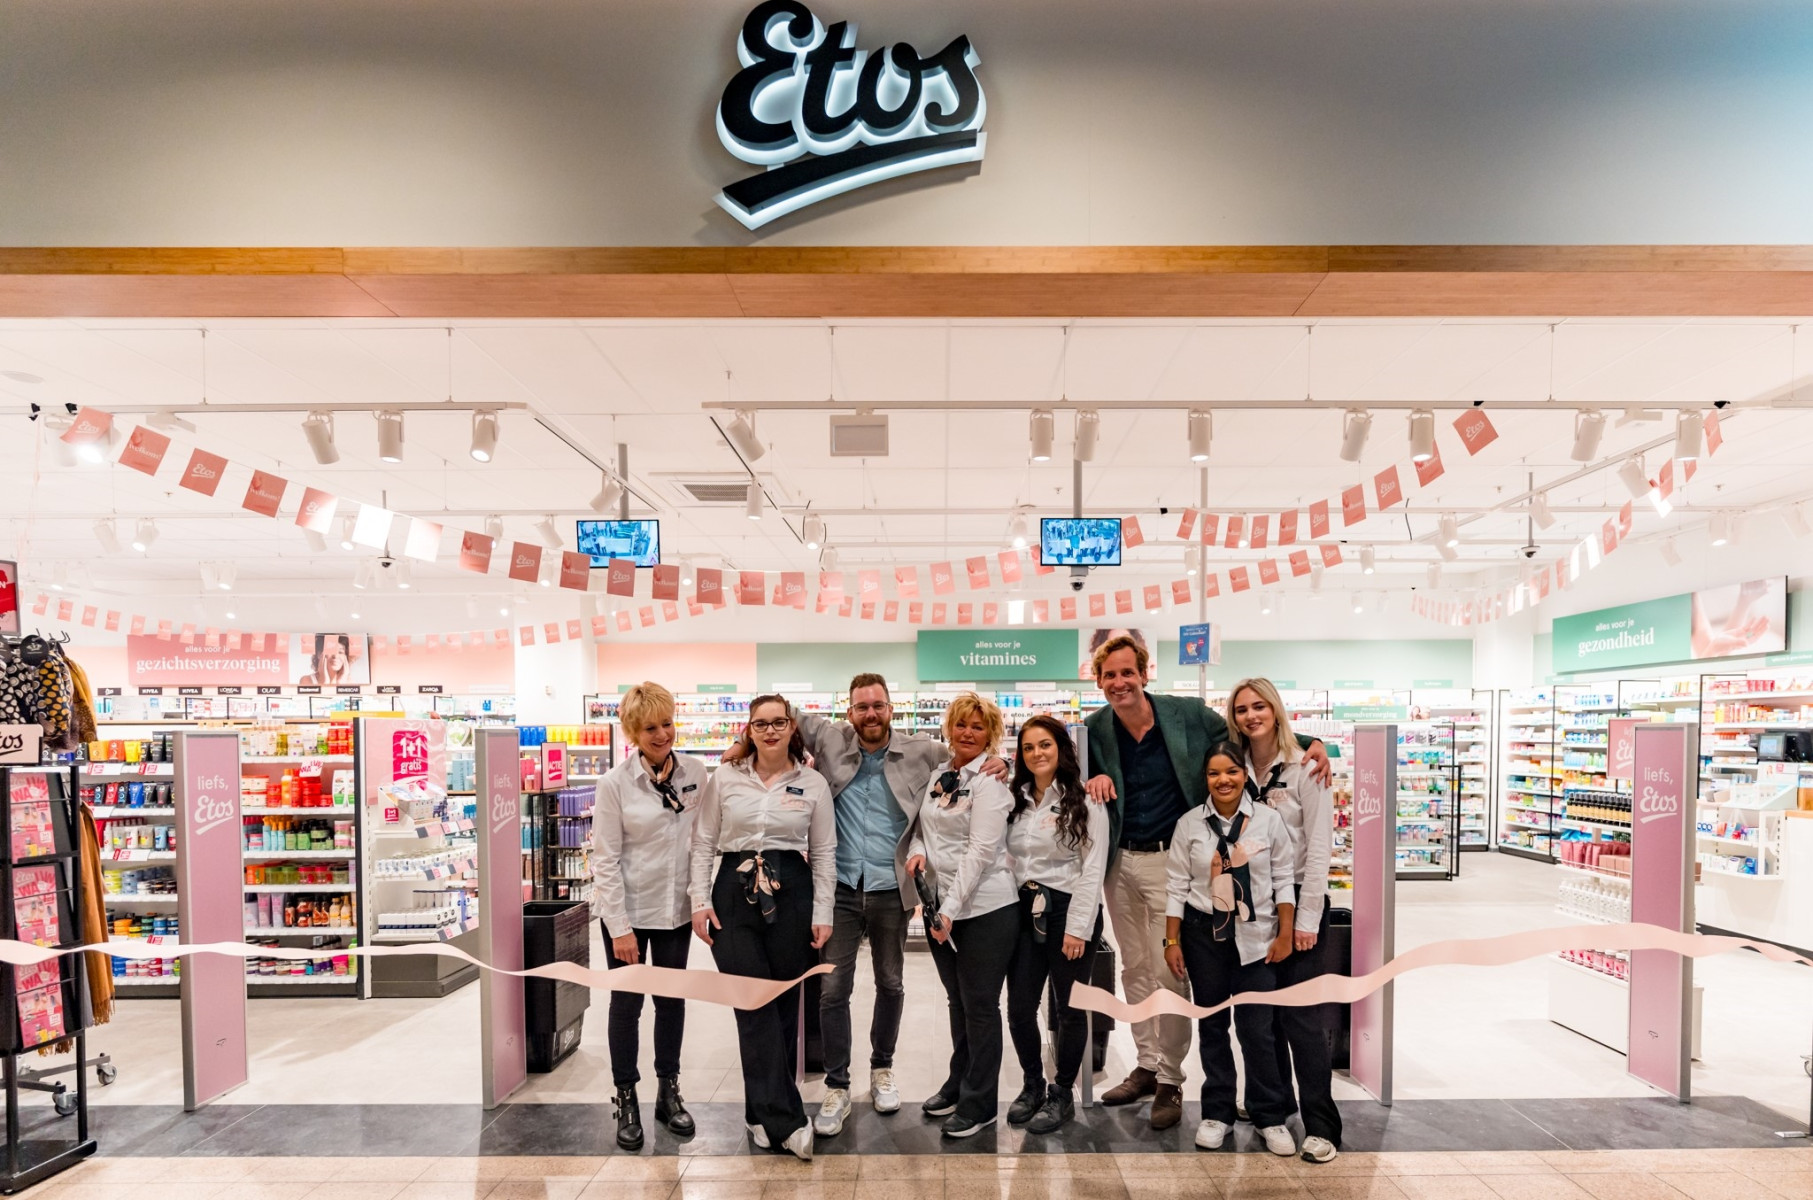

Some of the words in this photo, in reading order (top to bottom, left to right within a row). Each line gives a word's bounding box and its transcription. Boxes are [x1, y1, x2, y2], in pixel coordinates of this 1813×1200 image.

[716, 0, 987, 165] Etos
[192, 463, 216, 479] Etos
[1595, 622, 1610, 632] alles
[1611, 620, 1626, 630] voor
[184, 644, 202, 653] alles
[975, 641, 993, 649] alles
[1013, 640, 1021, 650] je
[1577, 627, 1655, 658] gezondheid
[136, 656, 281, 674] gezichtsverzorging
[959, 652, 1037, 666] vitamines
[400, 737, 423, 759] 1+1
[400, 759, 423, 775] gratis
[1644, 767, 1674, 785] liefs,
[197, 775, 229, 791] liefs,
[492, 793, 517, 822] Etos
[1357, 787, 1382, 815] Etos
[1639, 786, 1678, 813] Etos
[194, 795, 235, 823] Etos
